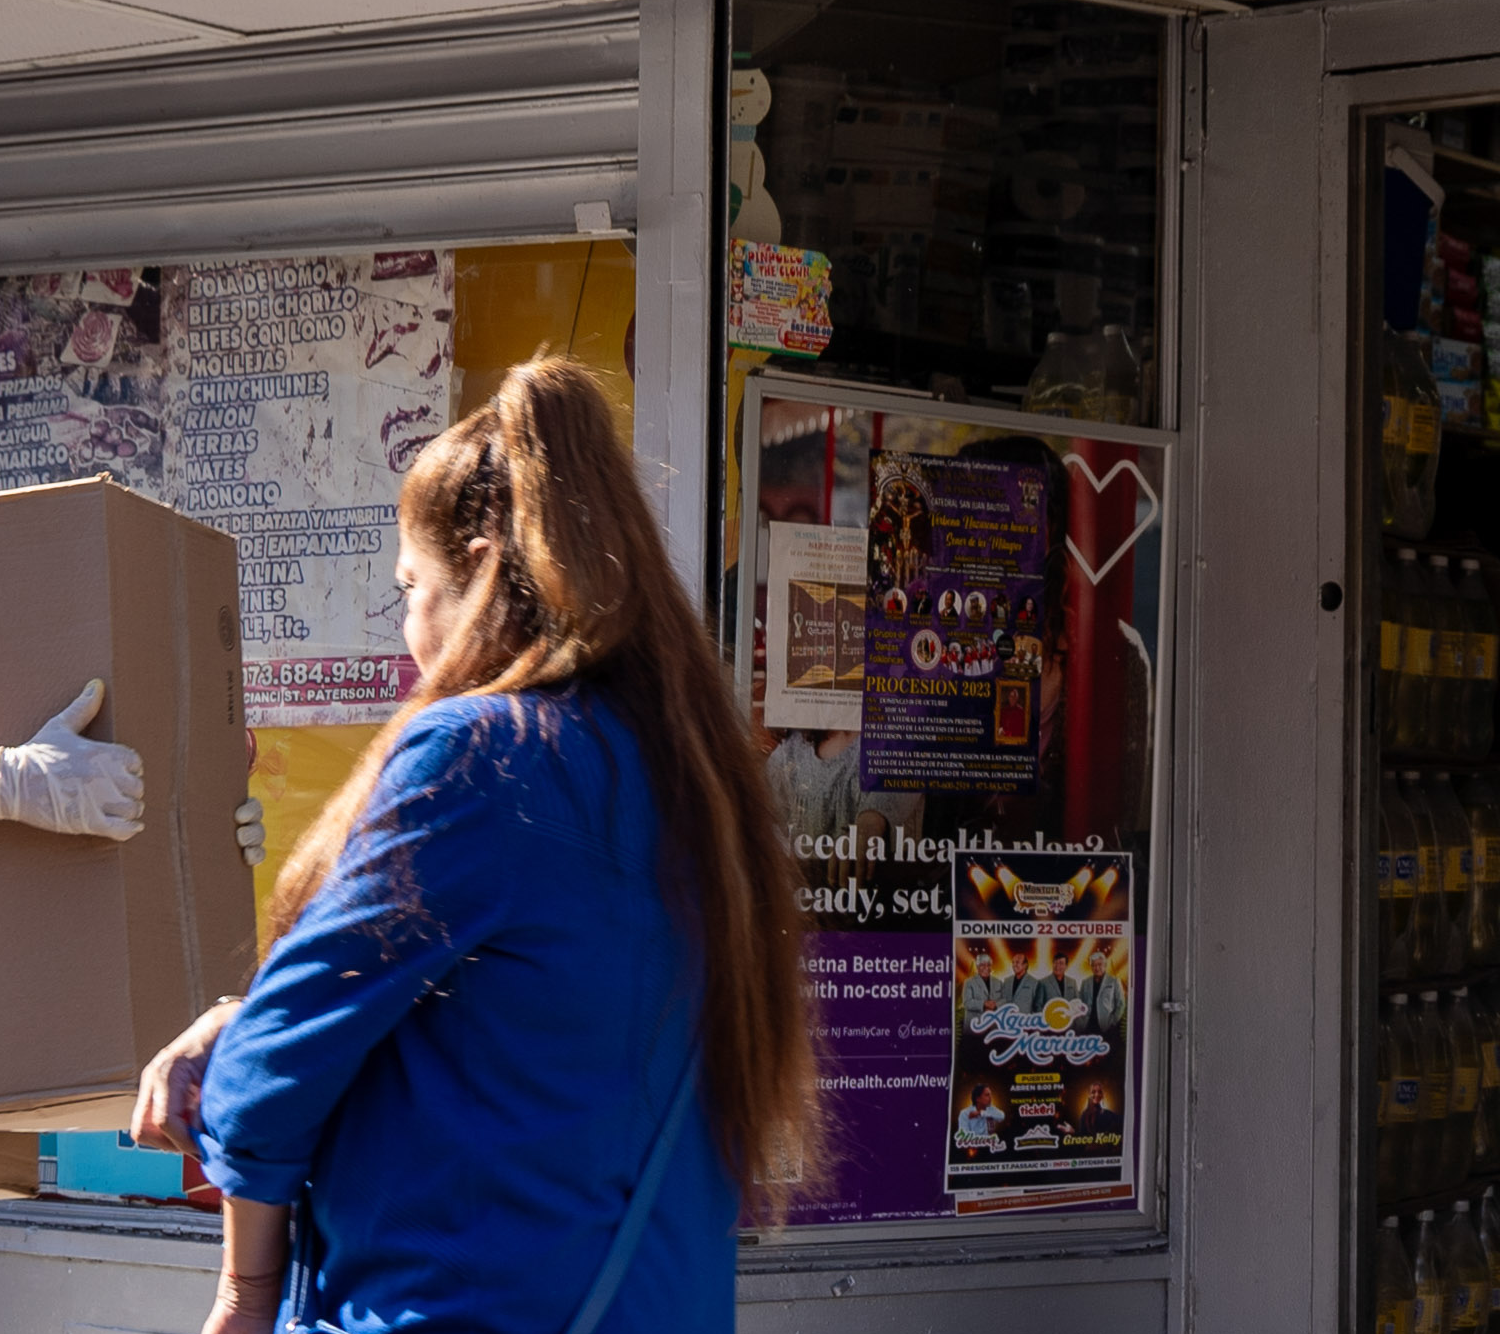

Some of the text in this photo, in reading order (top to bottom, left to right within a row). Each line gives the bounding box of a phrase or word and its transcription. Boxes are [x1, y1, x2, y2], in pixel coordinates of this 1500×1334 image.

[188, 271, 241, 301] BOLA
[243, 268, 270, 297] DE
[272, 263, 329, 291] LOMO
[187, 286, 360, 328] BIFES DE CHORIZO
[187, 314, 346, 354] BIFES CON LOMO
[188, 348, 288, 381] MOLLEJAS
[0, 373, 64, 398] FRIZADOS
[188, 370, 330, 407] CHINCHULINES
[6, 397, 70, 421] PERUANA
[182, 429, 259, 458] YERBAS
[185, 456, 247, 486] MATES
[187, 480, 282, 512] PIONONO
[230, 505, 401, 534] DE BATATA Y MEMBRILL
[239, 528, 382, 560] DE EMPANADAS
[284, 684, 397, 703] ST. PATERSON NJ
[866, 675, 992, 697] PROCESIÓN 2023
[866, 835, 887, 863] a
[961, 923, 1123, 935] DOMINGO 22 OCTUBRE
[852, 954, 906, 974] Better
[843, 981, 944, 1000] no-cost and
[843, 1025, 891, 1039] FamilyCare
